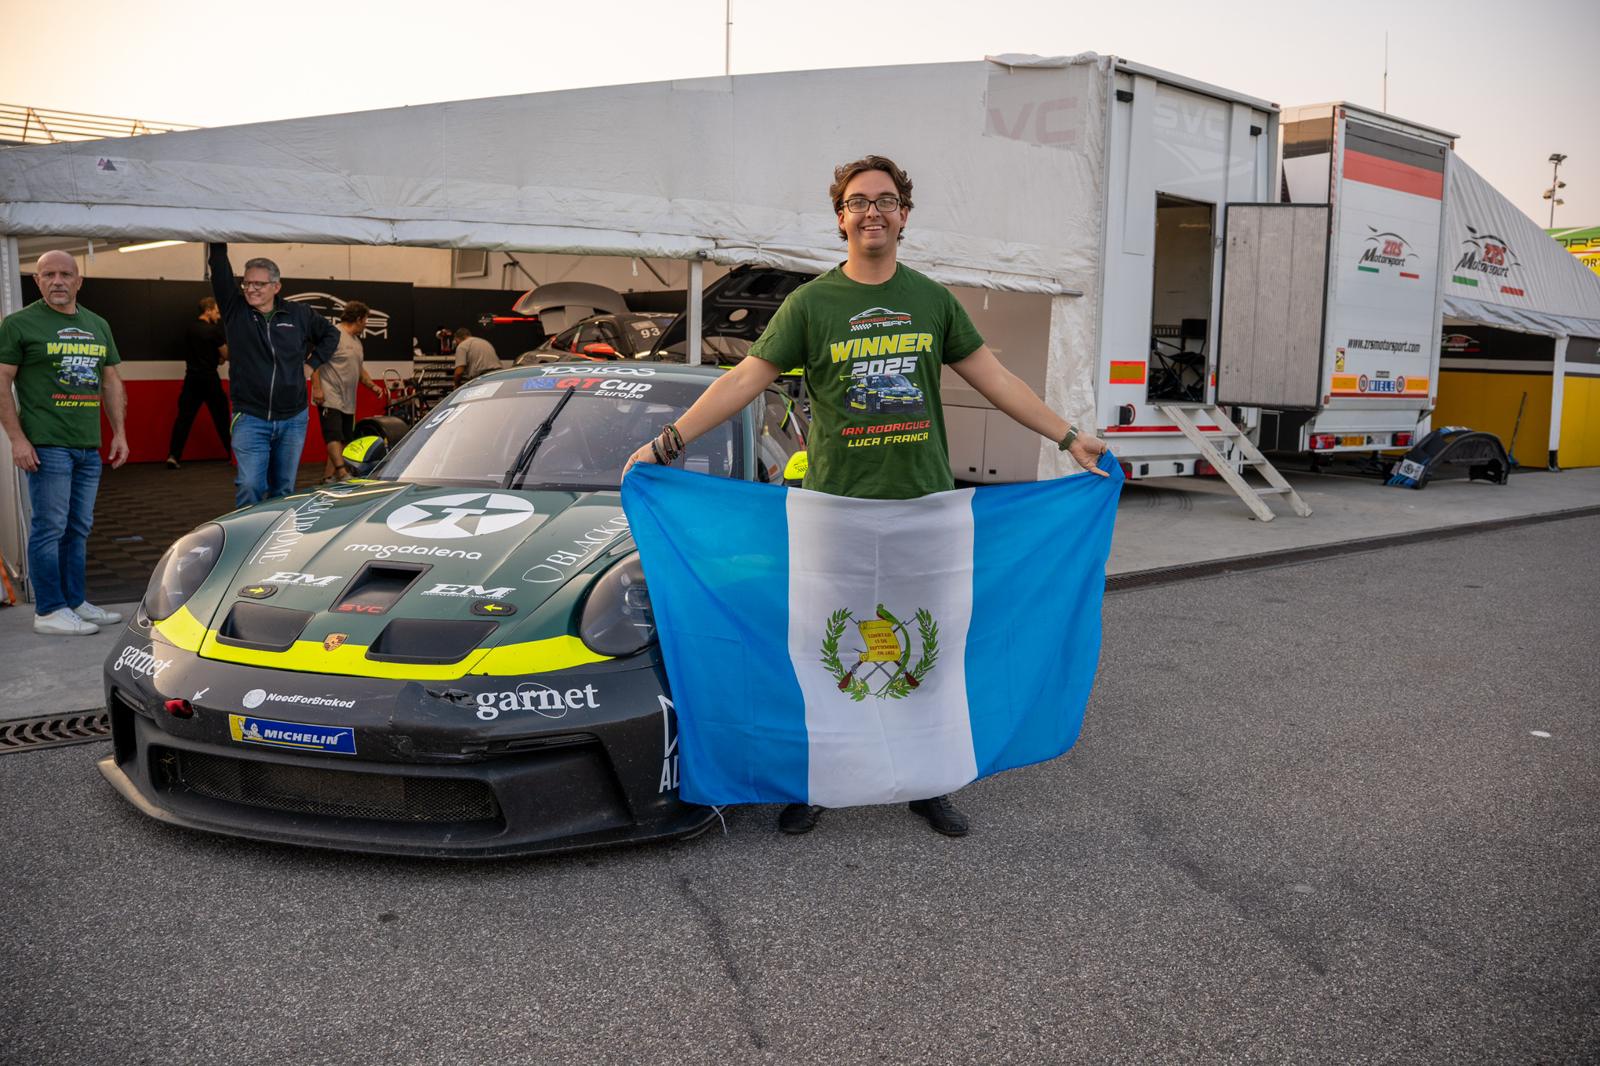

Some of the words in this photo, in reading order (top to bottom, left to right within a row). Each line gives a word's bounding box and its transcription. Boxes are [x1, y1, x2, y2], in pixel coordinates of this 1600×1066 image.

[1382, 239, 1403, 257] ZRS
[1359, 247, 1406, 267] Motorsport
[640, 327, 661, 339] 93
[46, 342, 107, 357] WINNER
[830, 333, 933, 364] WINNER
[1347, 339, 1421, 354] www.zrsmotorsport.com
[60, 355, 100, 368] 2025
[851, 356, 918, 378] 2025
[594, 389, 644, 400] Europe
[599, 379, 652, 395] Cup
[841, 426, 865, 436] IAN
[866, 420, 932, 435] RODRIGUEZ
[847, 437, 881, 448] LUCA
[343, 543, 483, 561] magdalena
[338, 603, 386, 613] SVC
[113, 645, 173, 679] garnet
[475, 683, 600, 721] garnet
[264, 728, 339, 746] MICHELIN
